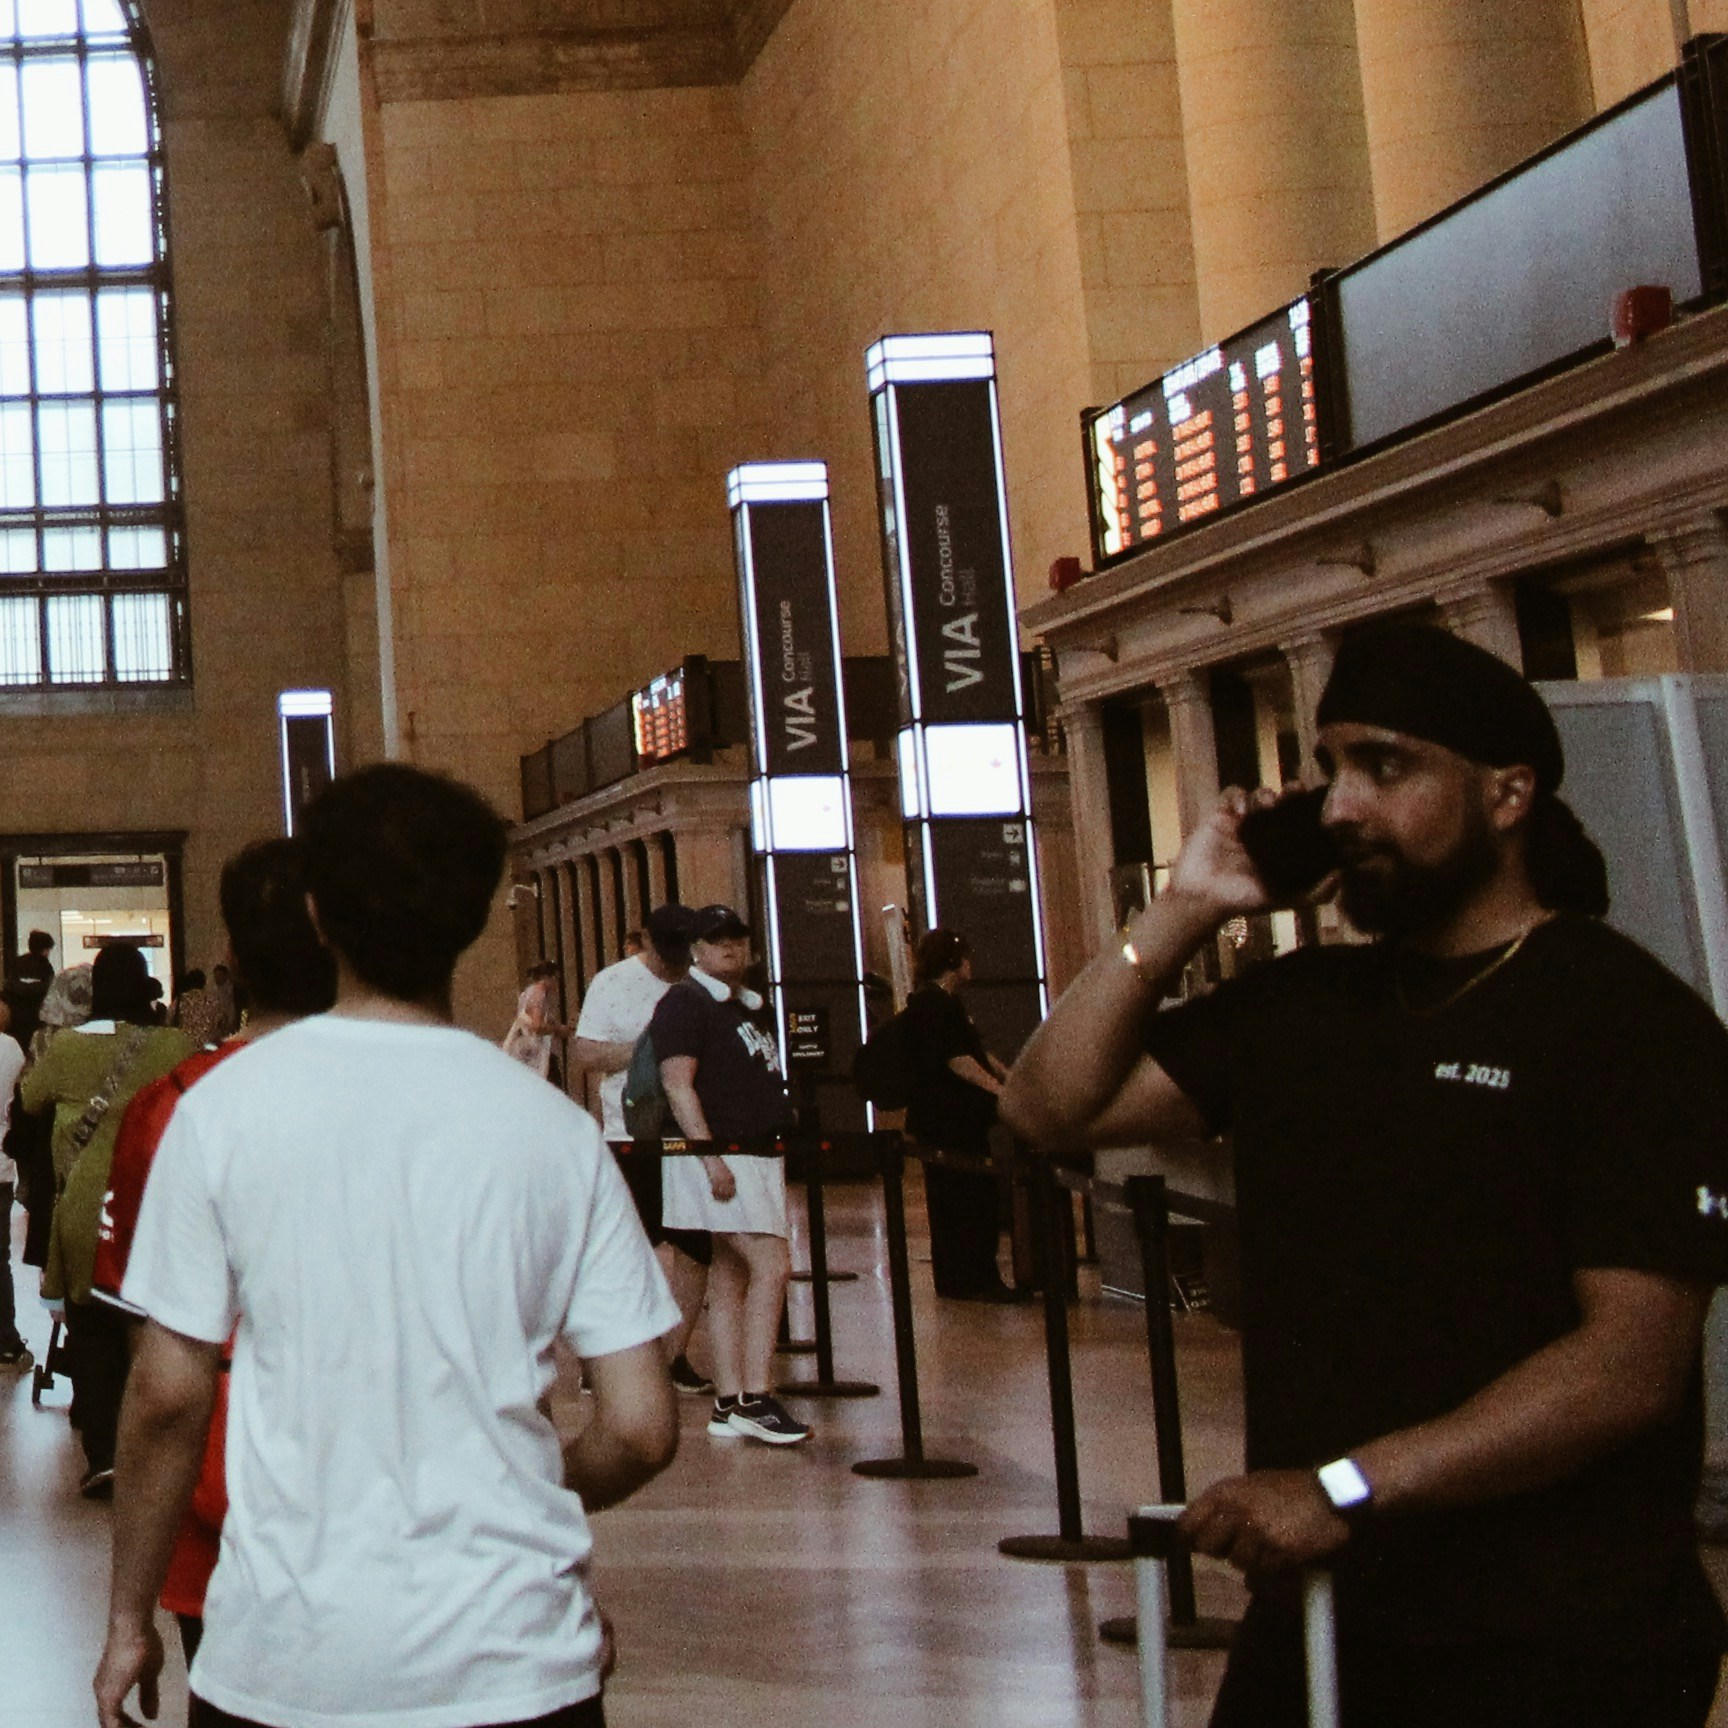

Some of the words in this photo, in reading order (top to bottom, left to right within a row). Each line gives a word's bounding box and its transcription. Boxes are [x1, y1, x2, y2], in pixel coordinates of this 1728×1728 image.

[935, 504, 956, 606] Concourse
[780, 600, 795, 682] Concourse
[942, 612, 984, 693] VIA
[783, 686, 818, 752] VIA
